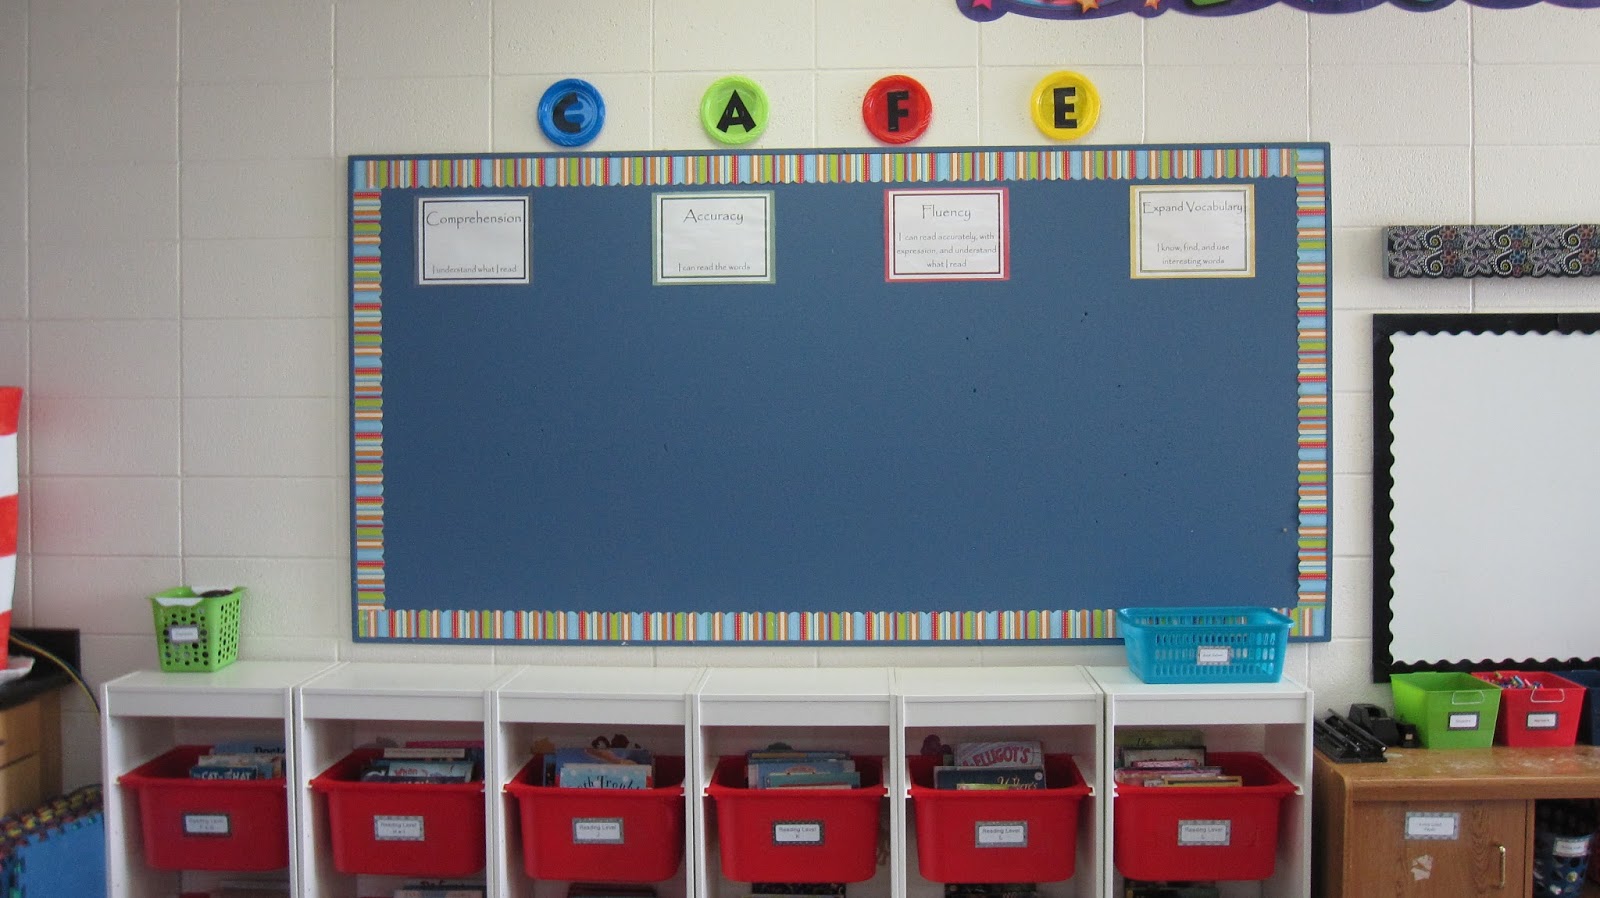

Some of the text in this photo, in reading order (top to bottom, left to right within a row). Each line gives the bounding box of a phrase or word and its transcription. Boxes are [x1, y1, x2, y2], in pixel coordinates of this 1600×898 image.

[552, 87, 1078, 133] C A F E
[921, 204, 971, 221] Fluency
[1142, 200, 1243, 216] Expand Vocabulary
[426, 210, 522, 229] Comprehension
[683, 208, 744, 225] Accuracy
[919, 232, 936, 241] read
[938, 231, 979, 243] accurately,
[980, 231, 995, 240] with
[896, 245, 997, 257] expression, and understand
[1161, 242, 1183, 252] know,
[1183, 242, 1200, 251] find,
[1201, 242, 1216, 251] and
[696, 262, 714, 271] read
[715, 262, 727, 271] the
[729, 262, 751, 271] words
[926, 259, 944, 268] what
[949, 258, 967, 267] read
[1162, 256, 1225, 267] interesting words
[436, 264, 477, 273] understand
[477, 264, 495, 273] what
[500, 264, 517, 273] read
